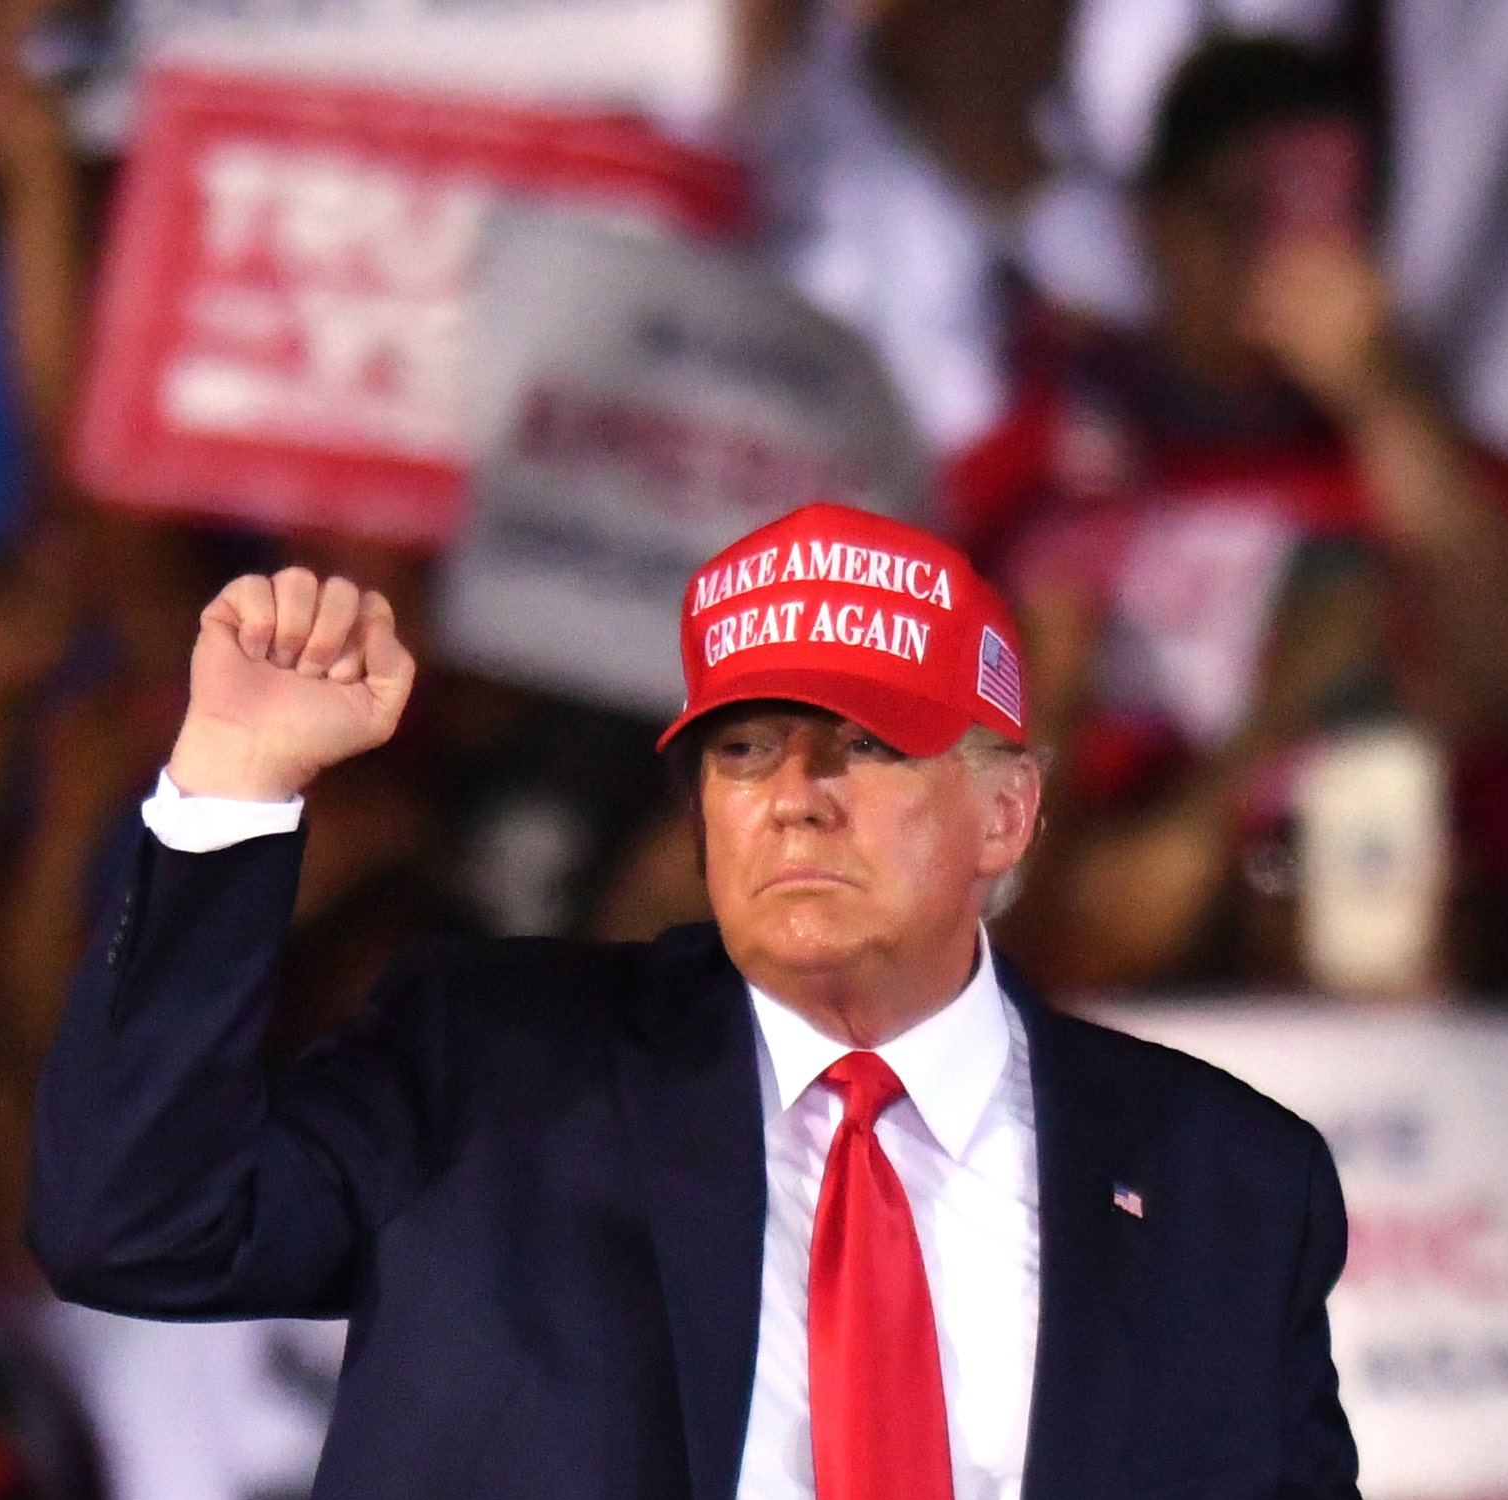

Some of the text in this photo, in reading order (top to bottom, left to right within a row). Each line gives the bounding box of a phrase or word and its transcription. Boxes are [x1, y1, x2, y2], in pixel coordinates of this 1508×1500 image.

[691, 541, 953, 618] MAKE AMERICA
[703, 601, 931, 668] GREAT AGAIN
